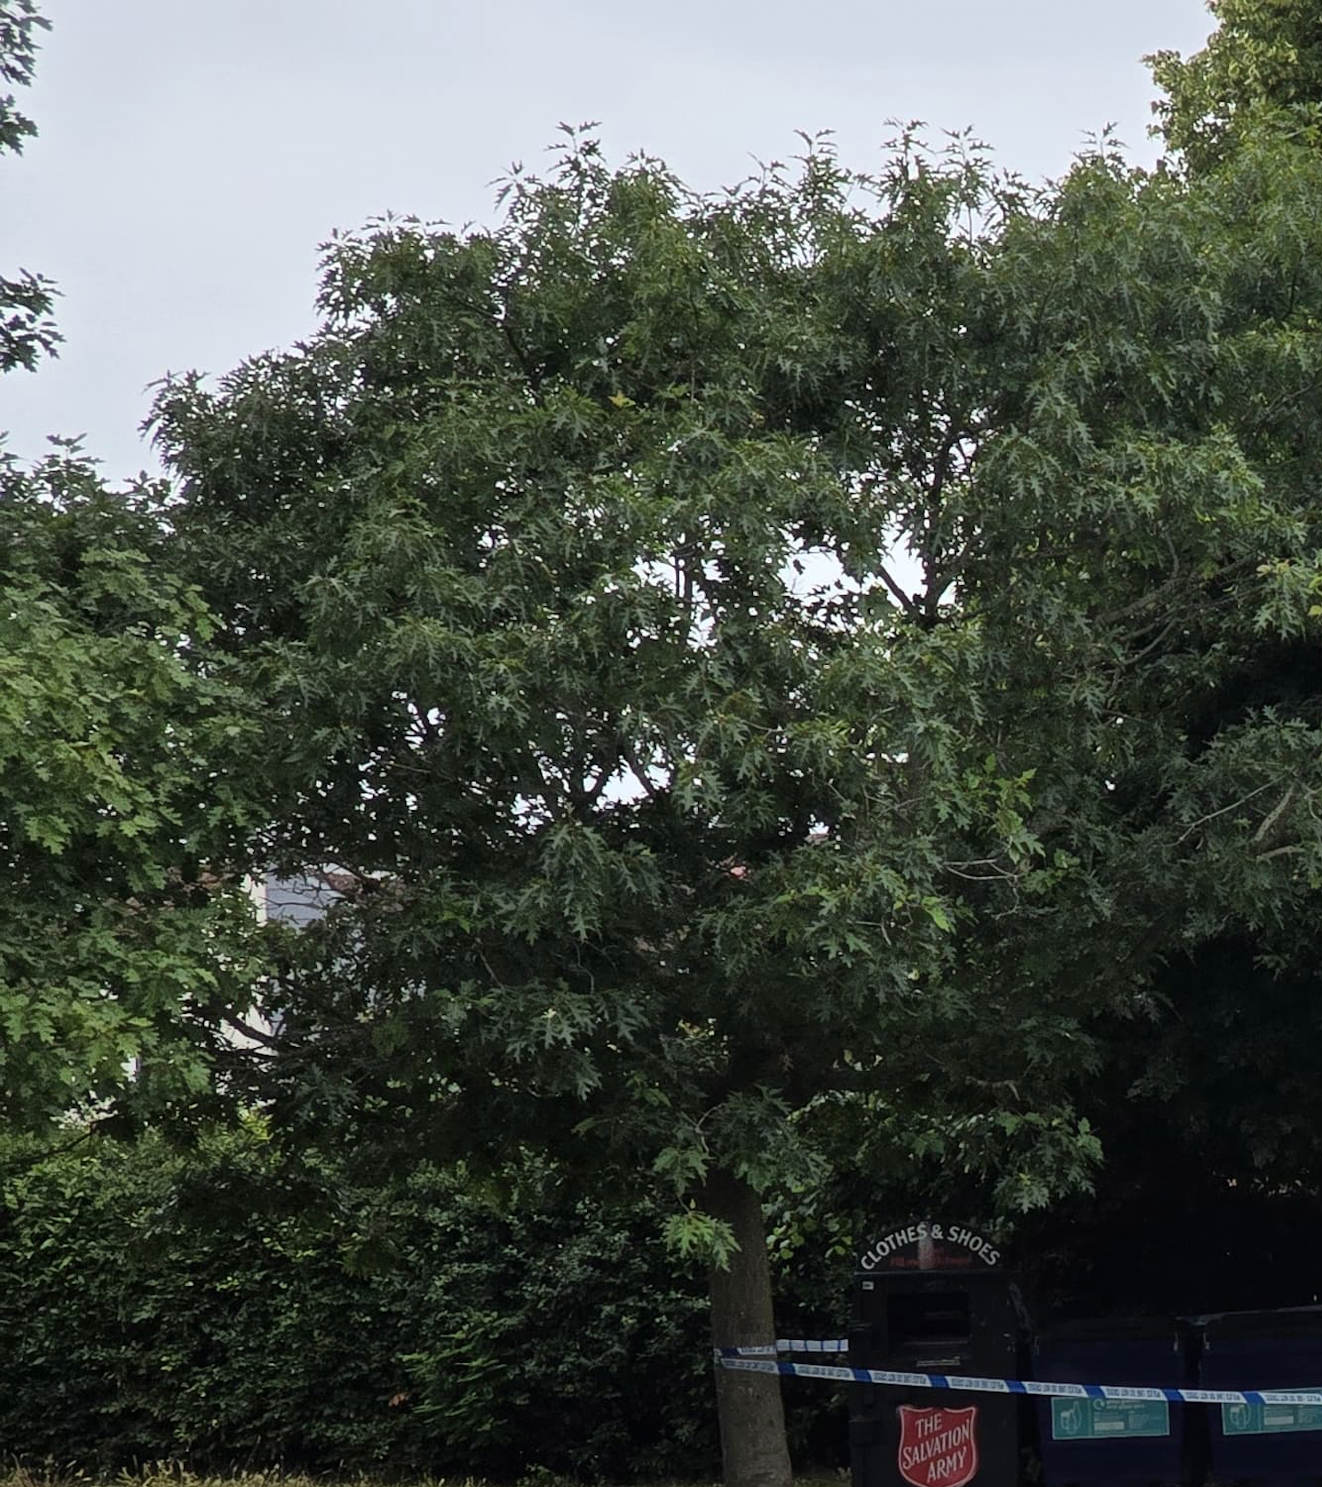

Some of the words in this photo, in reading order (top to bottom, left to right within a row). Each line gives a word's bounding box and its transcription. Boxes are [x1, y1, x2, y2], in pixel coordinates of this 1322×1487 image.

[861, 1223, 927, 1270] CLOTHES
[931, 1224, 944, 1239] &
[947, 1225, 1001, 1266] SHOES
[902, 1418, 970, 1470] SALVATION
[915, 1412, 942, 1439] THE
[927, 1446, 967, 1483] ARMY
